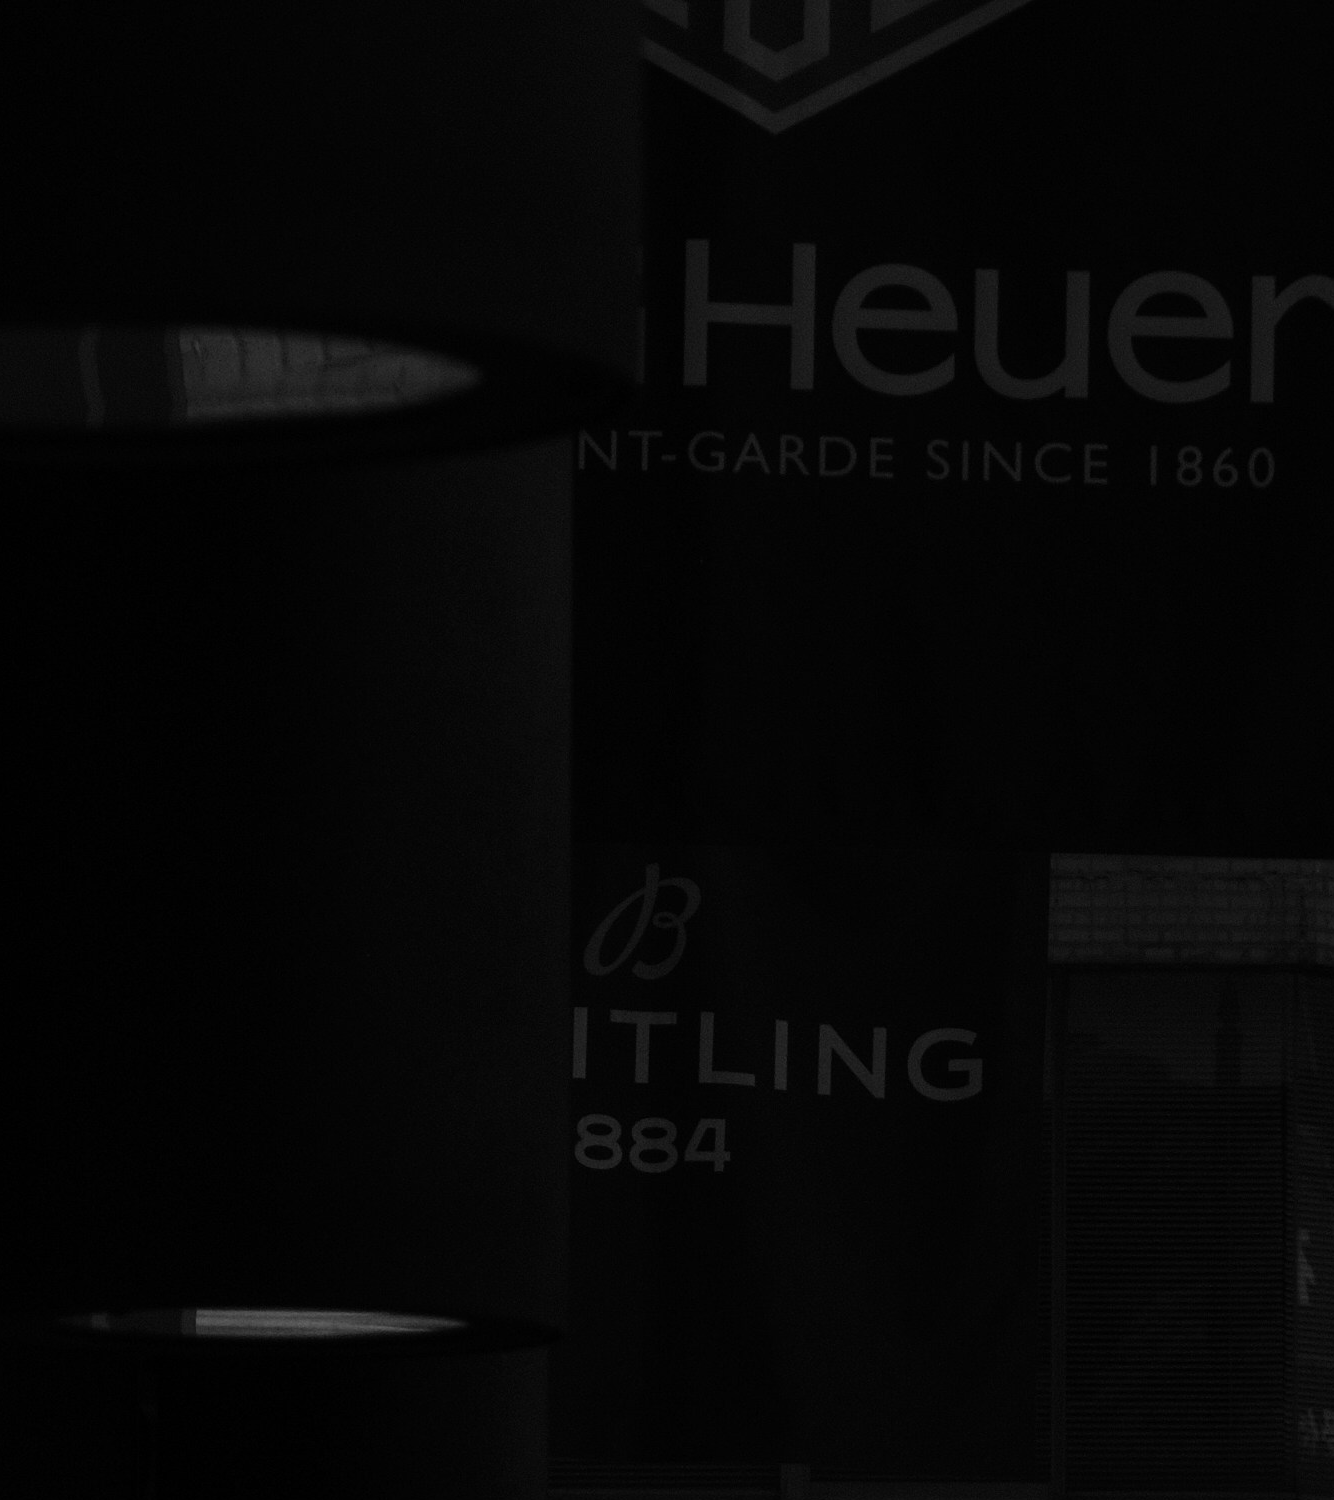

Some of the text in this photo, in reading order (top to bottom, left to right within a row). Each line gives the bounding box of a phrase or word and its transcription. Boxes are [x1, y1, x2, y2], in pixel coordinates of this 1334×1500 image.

[576, 428, 1277, 489] NT-GARDE SINCE 1860
[571, 1005, 984, 1102] ITLING
[573, 1113, 731, 1174] 884
